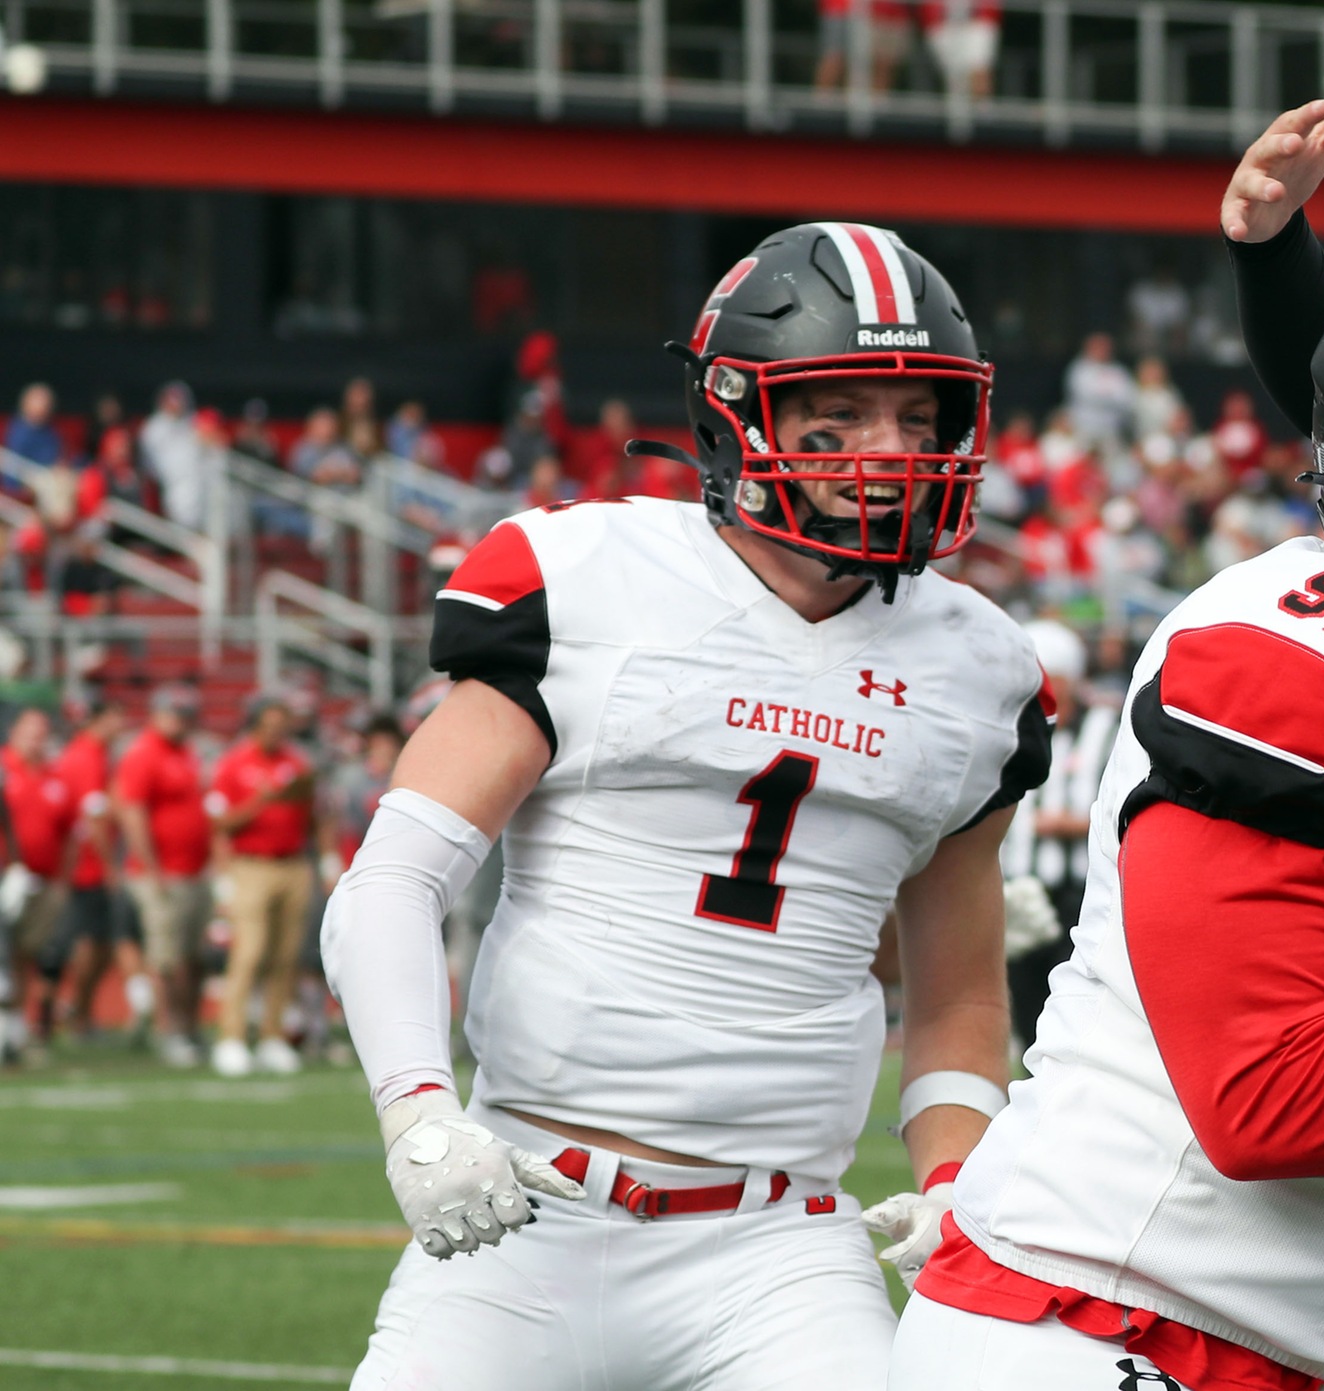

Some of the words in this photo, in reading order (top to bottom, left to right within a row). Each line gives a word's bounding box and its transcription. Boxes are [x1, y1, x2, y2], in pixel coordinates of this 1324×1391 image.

[857, 329, 930, 347] Riddell
[726, 698, 885, 758] CATHOLIC
[694, 748, 820, 934] 1
